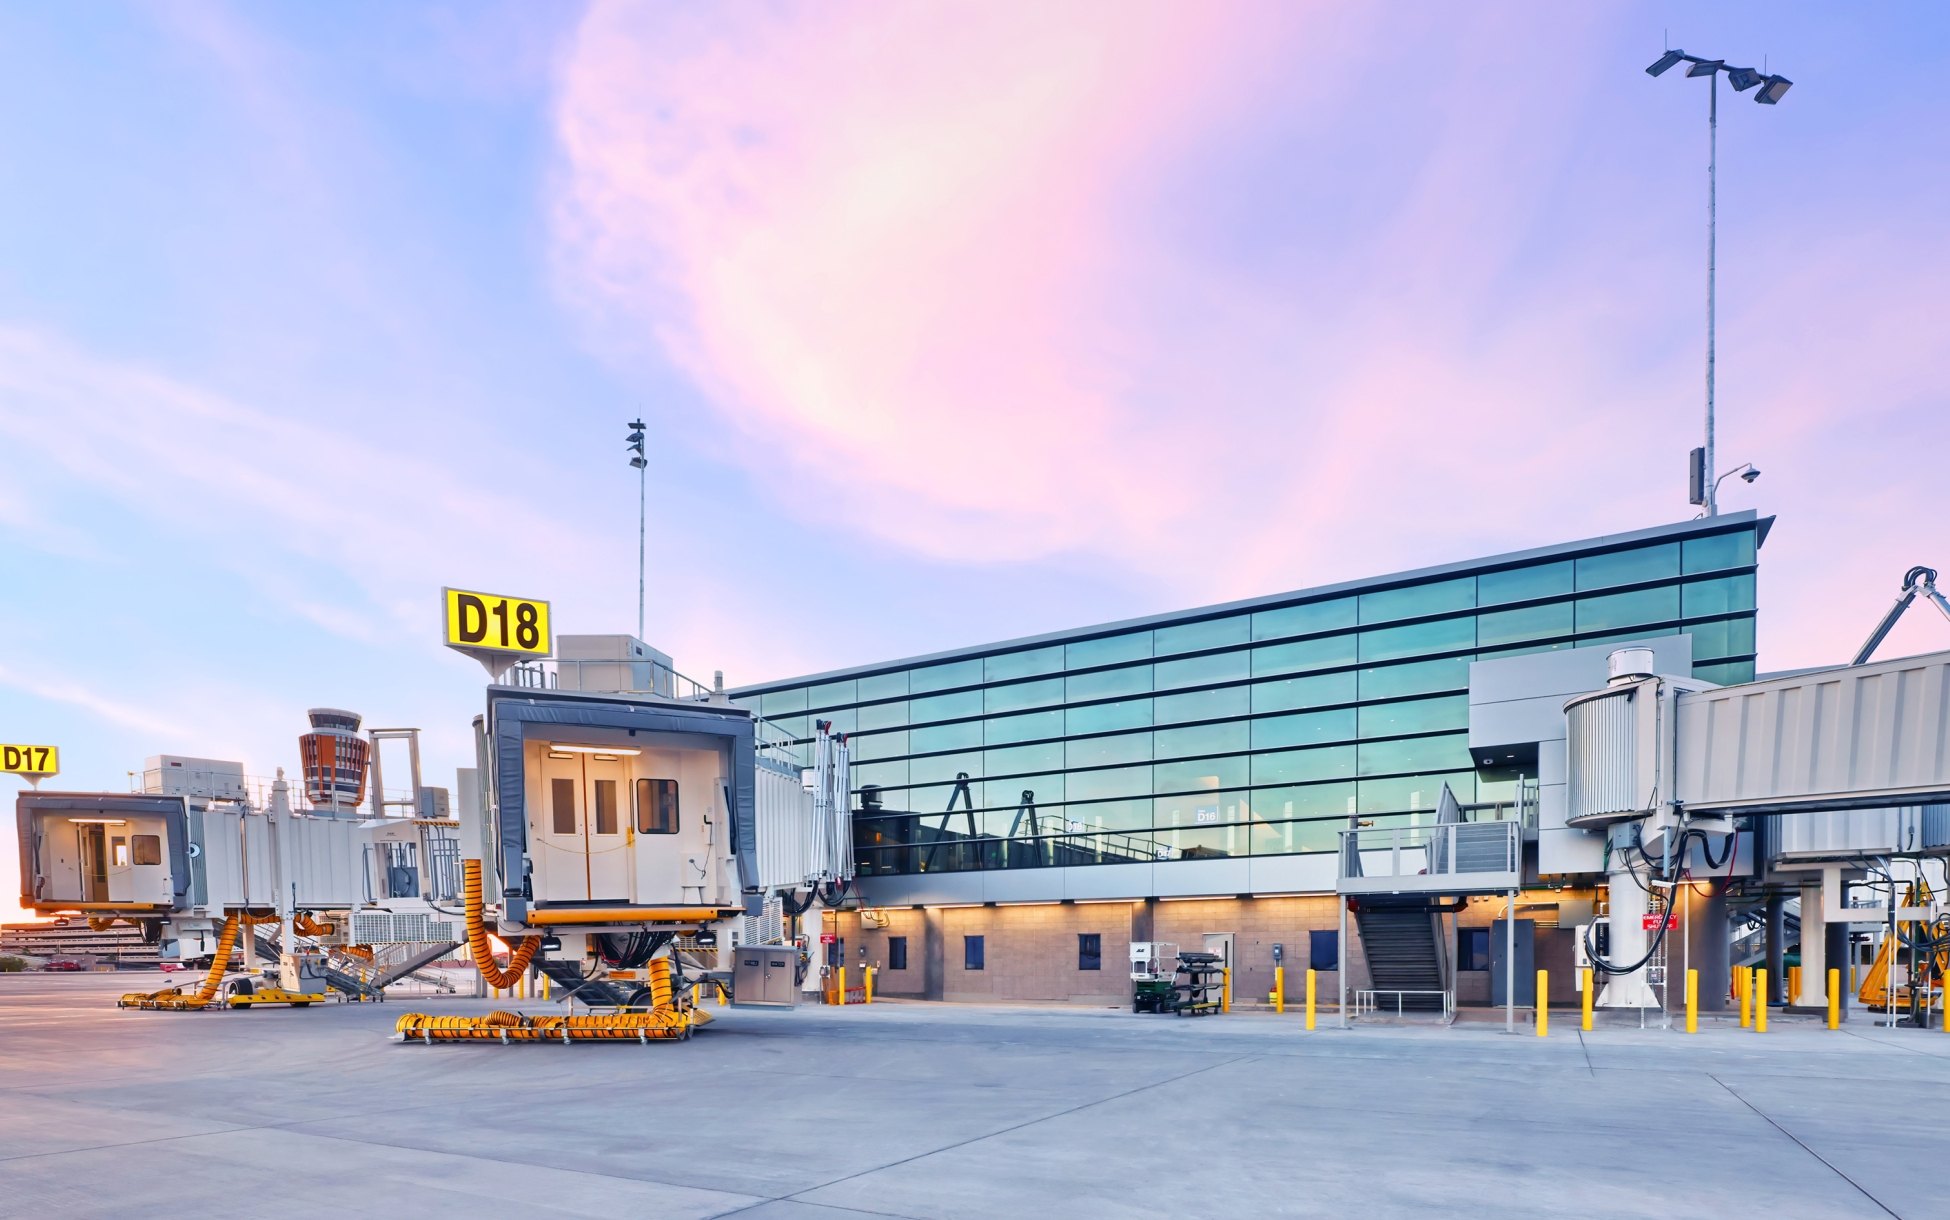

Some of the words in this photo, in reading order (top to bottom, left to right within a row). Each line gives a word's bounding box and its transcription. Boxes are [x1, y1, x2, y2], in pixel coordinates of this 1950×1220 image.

[458, 593, 539, 649] D18
[4, 746, 49, 771] D17
[1197, 811, 1216, 821] D16
